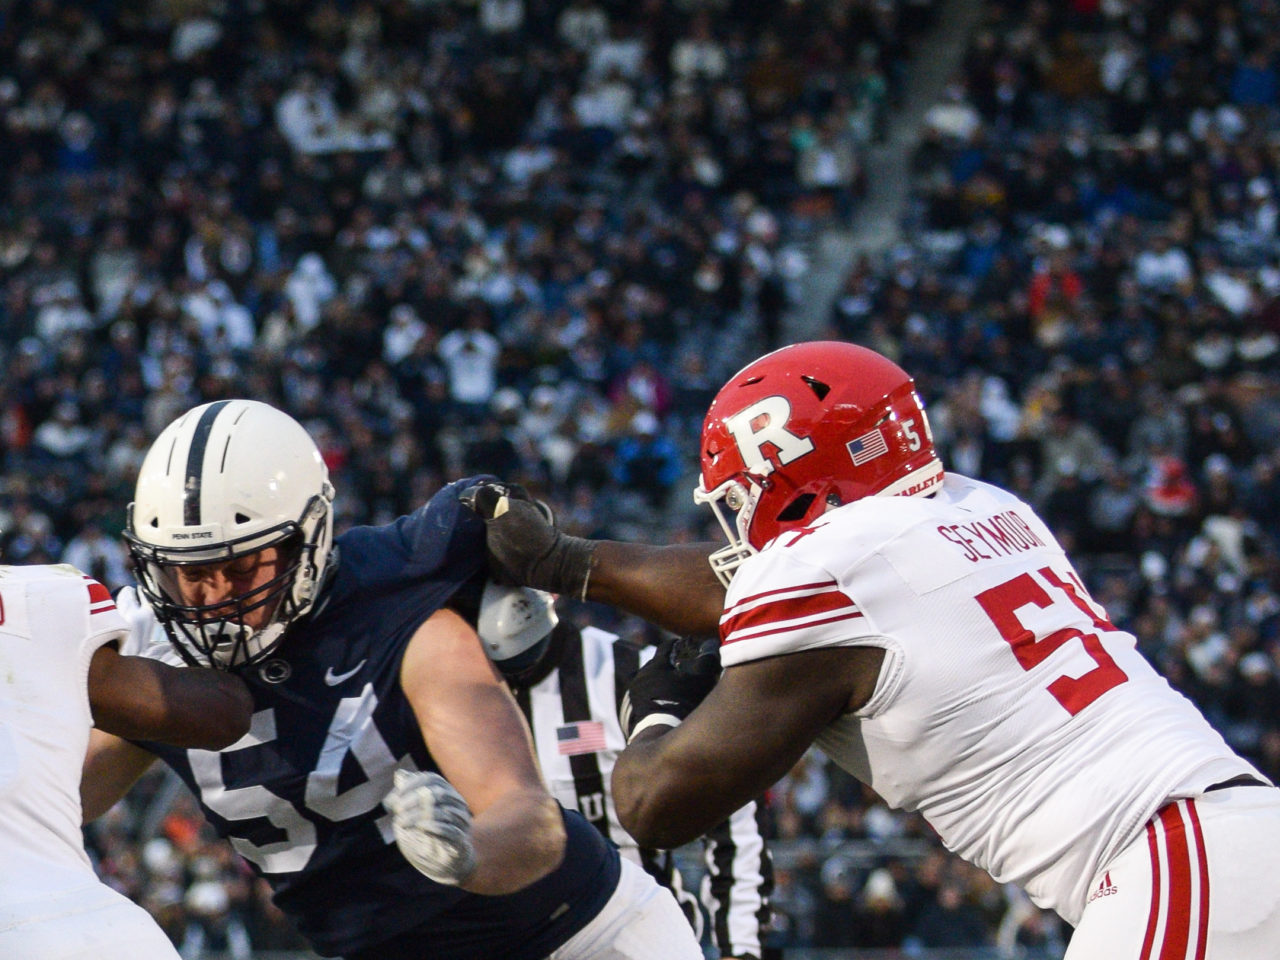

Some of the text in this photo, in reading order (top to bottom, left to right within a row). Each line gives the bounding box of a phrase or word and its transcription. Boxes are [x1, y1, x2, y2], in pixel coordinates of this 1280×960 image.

[726, 395, 816, 473] R
[895, 476, 935, 496] ARLET
[191, 531, 213, 539] STATE
[937, 510, 1046, 562] SEYMOUR
[187, 682, 421, 873] 54
[579, 792, 604, 822] U
